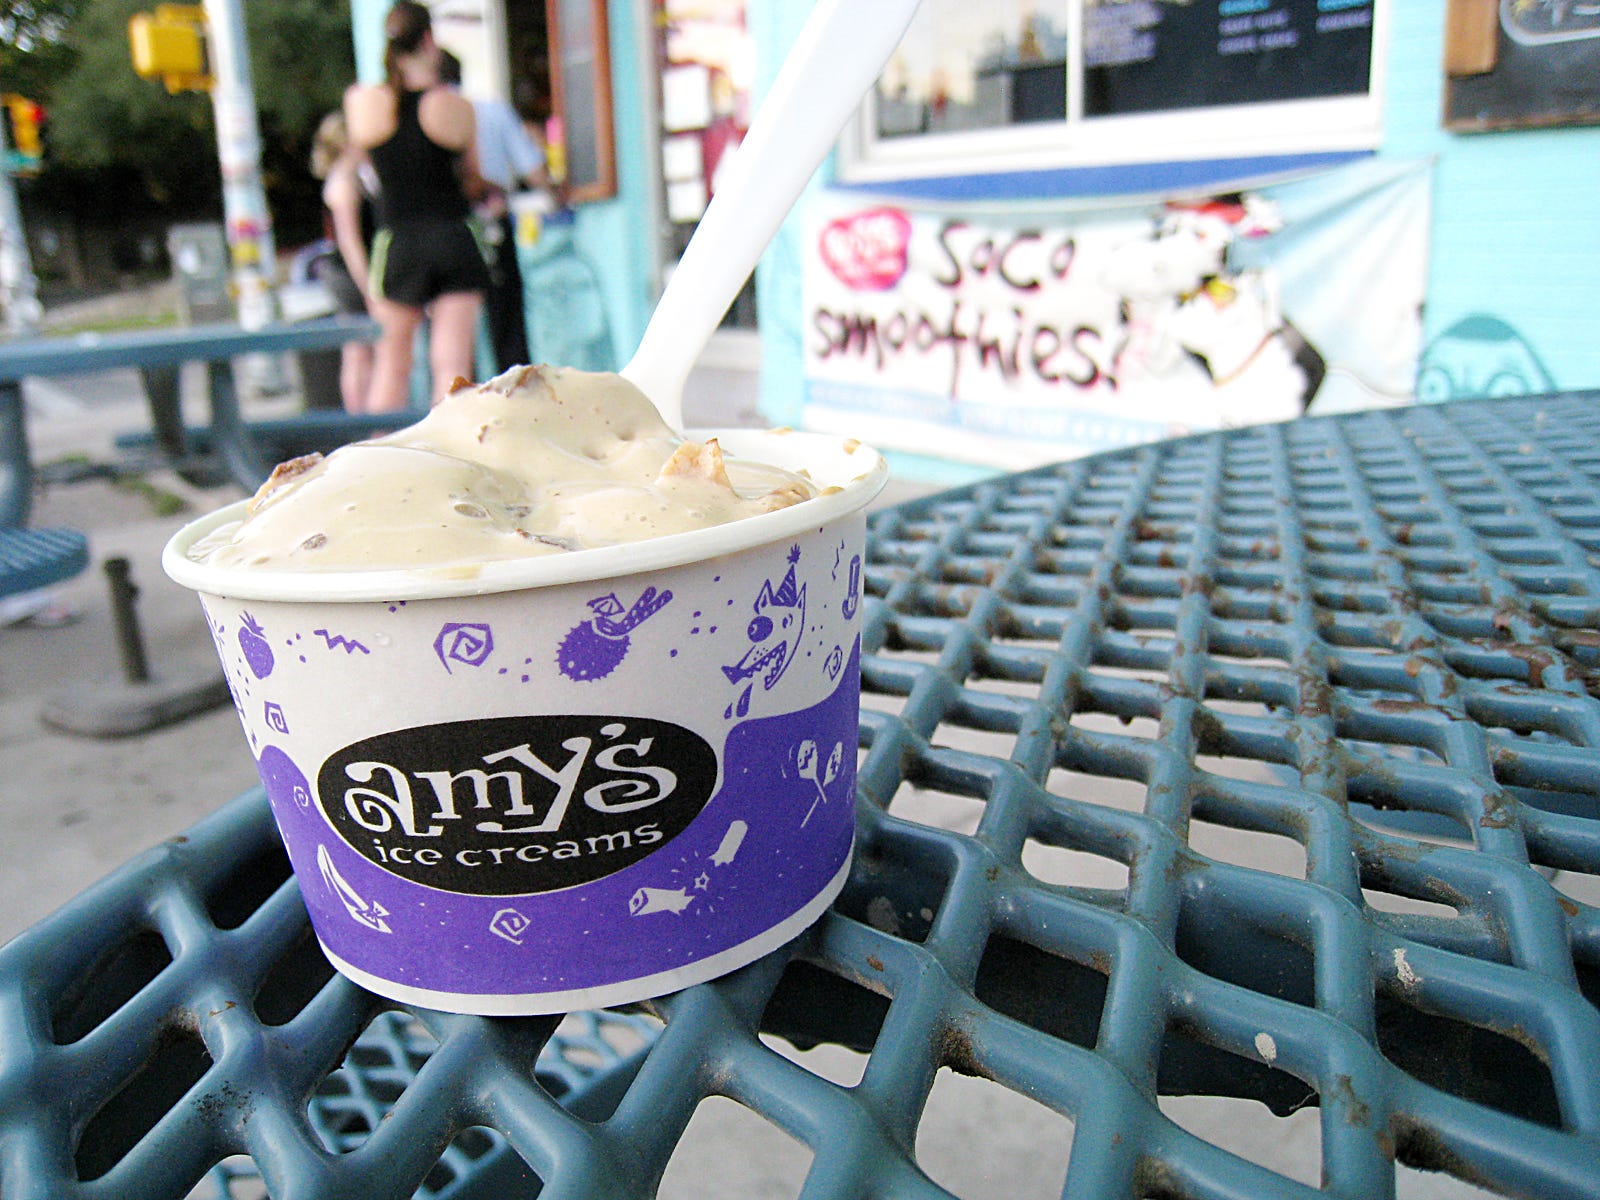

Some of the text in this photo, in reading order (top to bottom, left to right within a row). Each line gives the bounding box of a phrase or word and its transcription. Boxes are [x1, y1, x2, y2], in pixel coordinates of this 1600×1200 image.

[344, 723, 677, 837] amy's
[373, 822, 664, 867] ice creams
